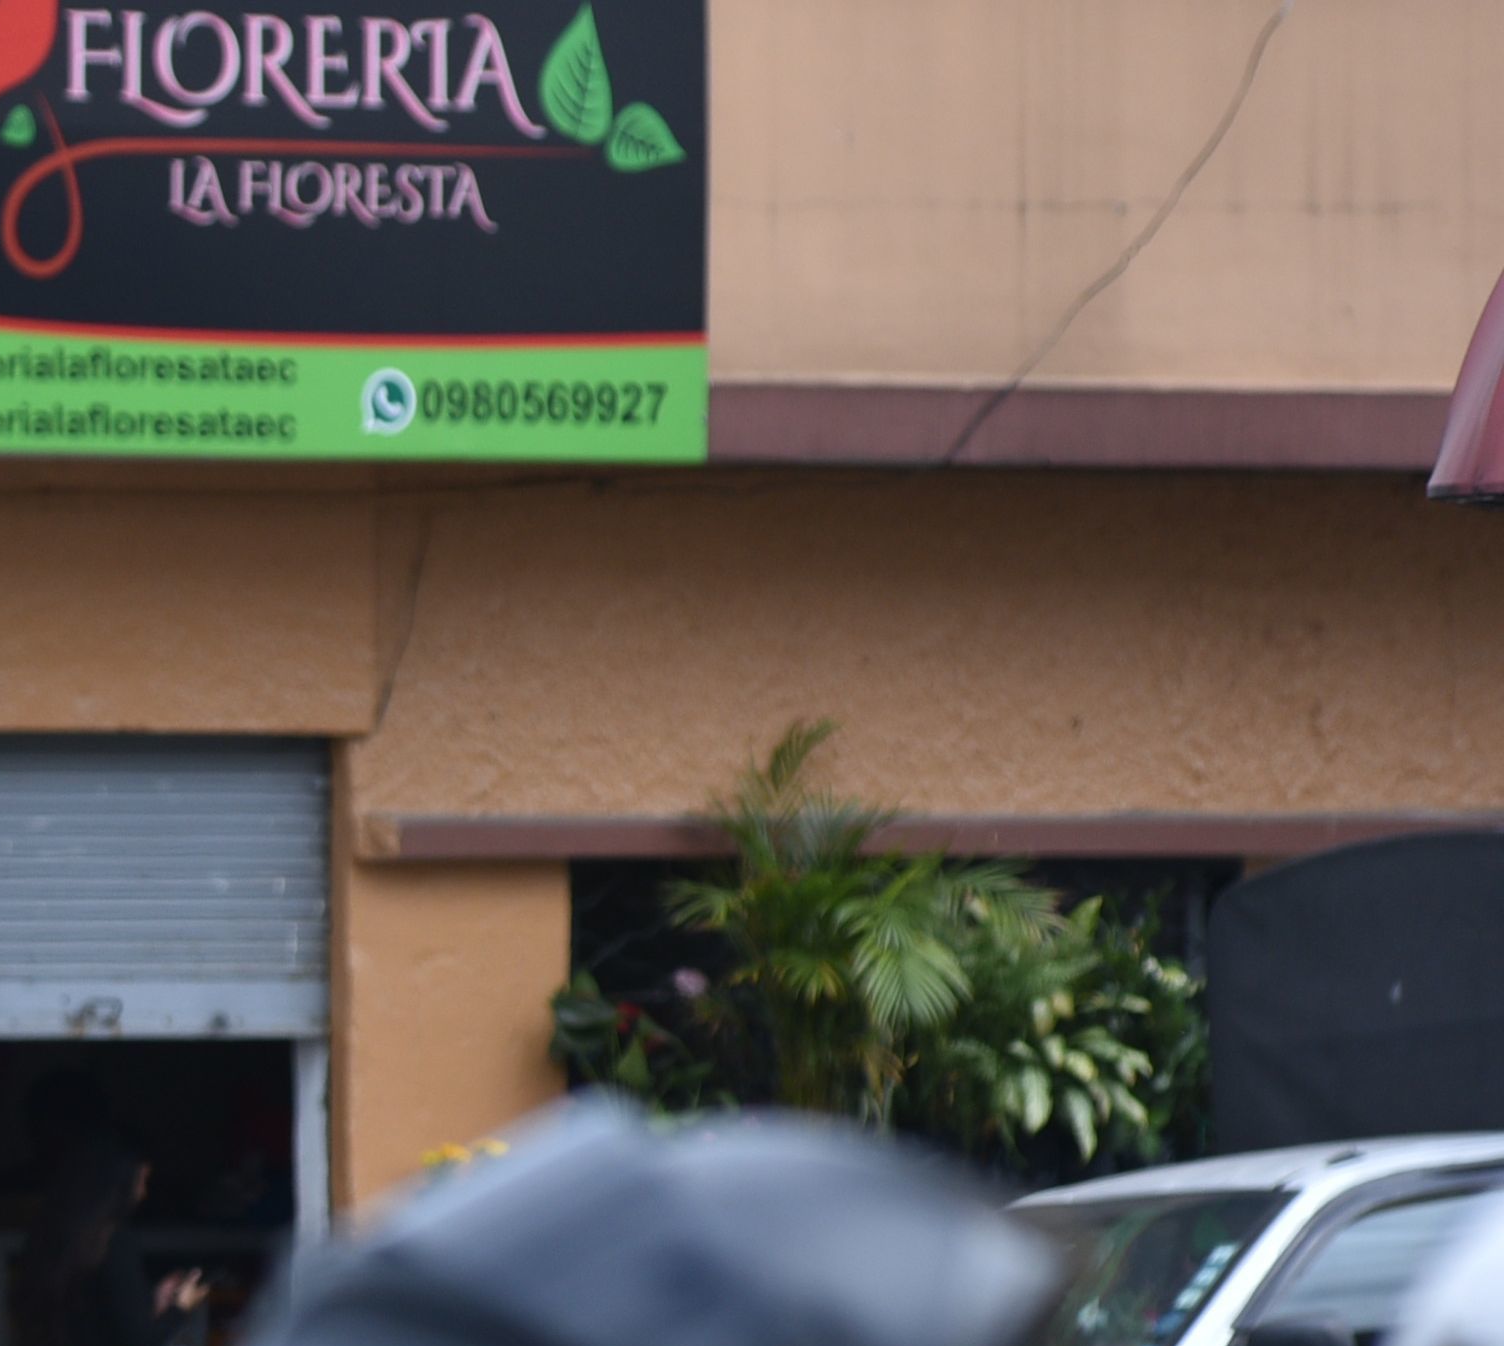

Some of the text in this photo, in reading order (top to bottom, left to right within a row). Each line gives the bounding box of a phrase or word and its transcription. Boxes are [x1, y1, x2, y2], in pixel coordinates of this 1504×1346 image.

[66, 8, 547, 139] FLORERIA
[168, 156, 500, 235] LA FLORESTA
[422, 379, 668, 424] 0980569927
